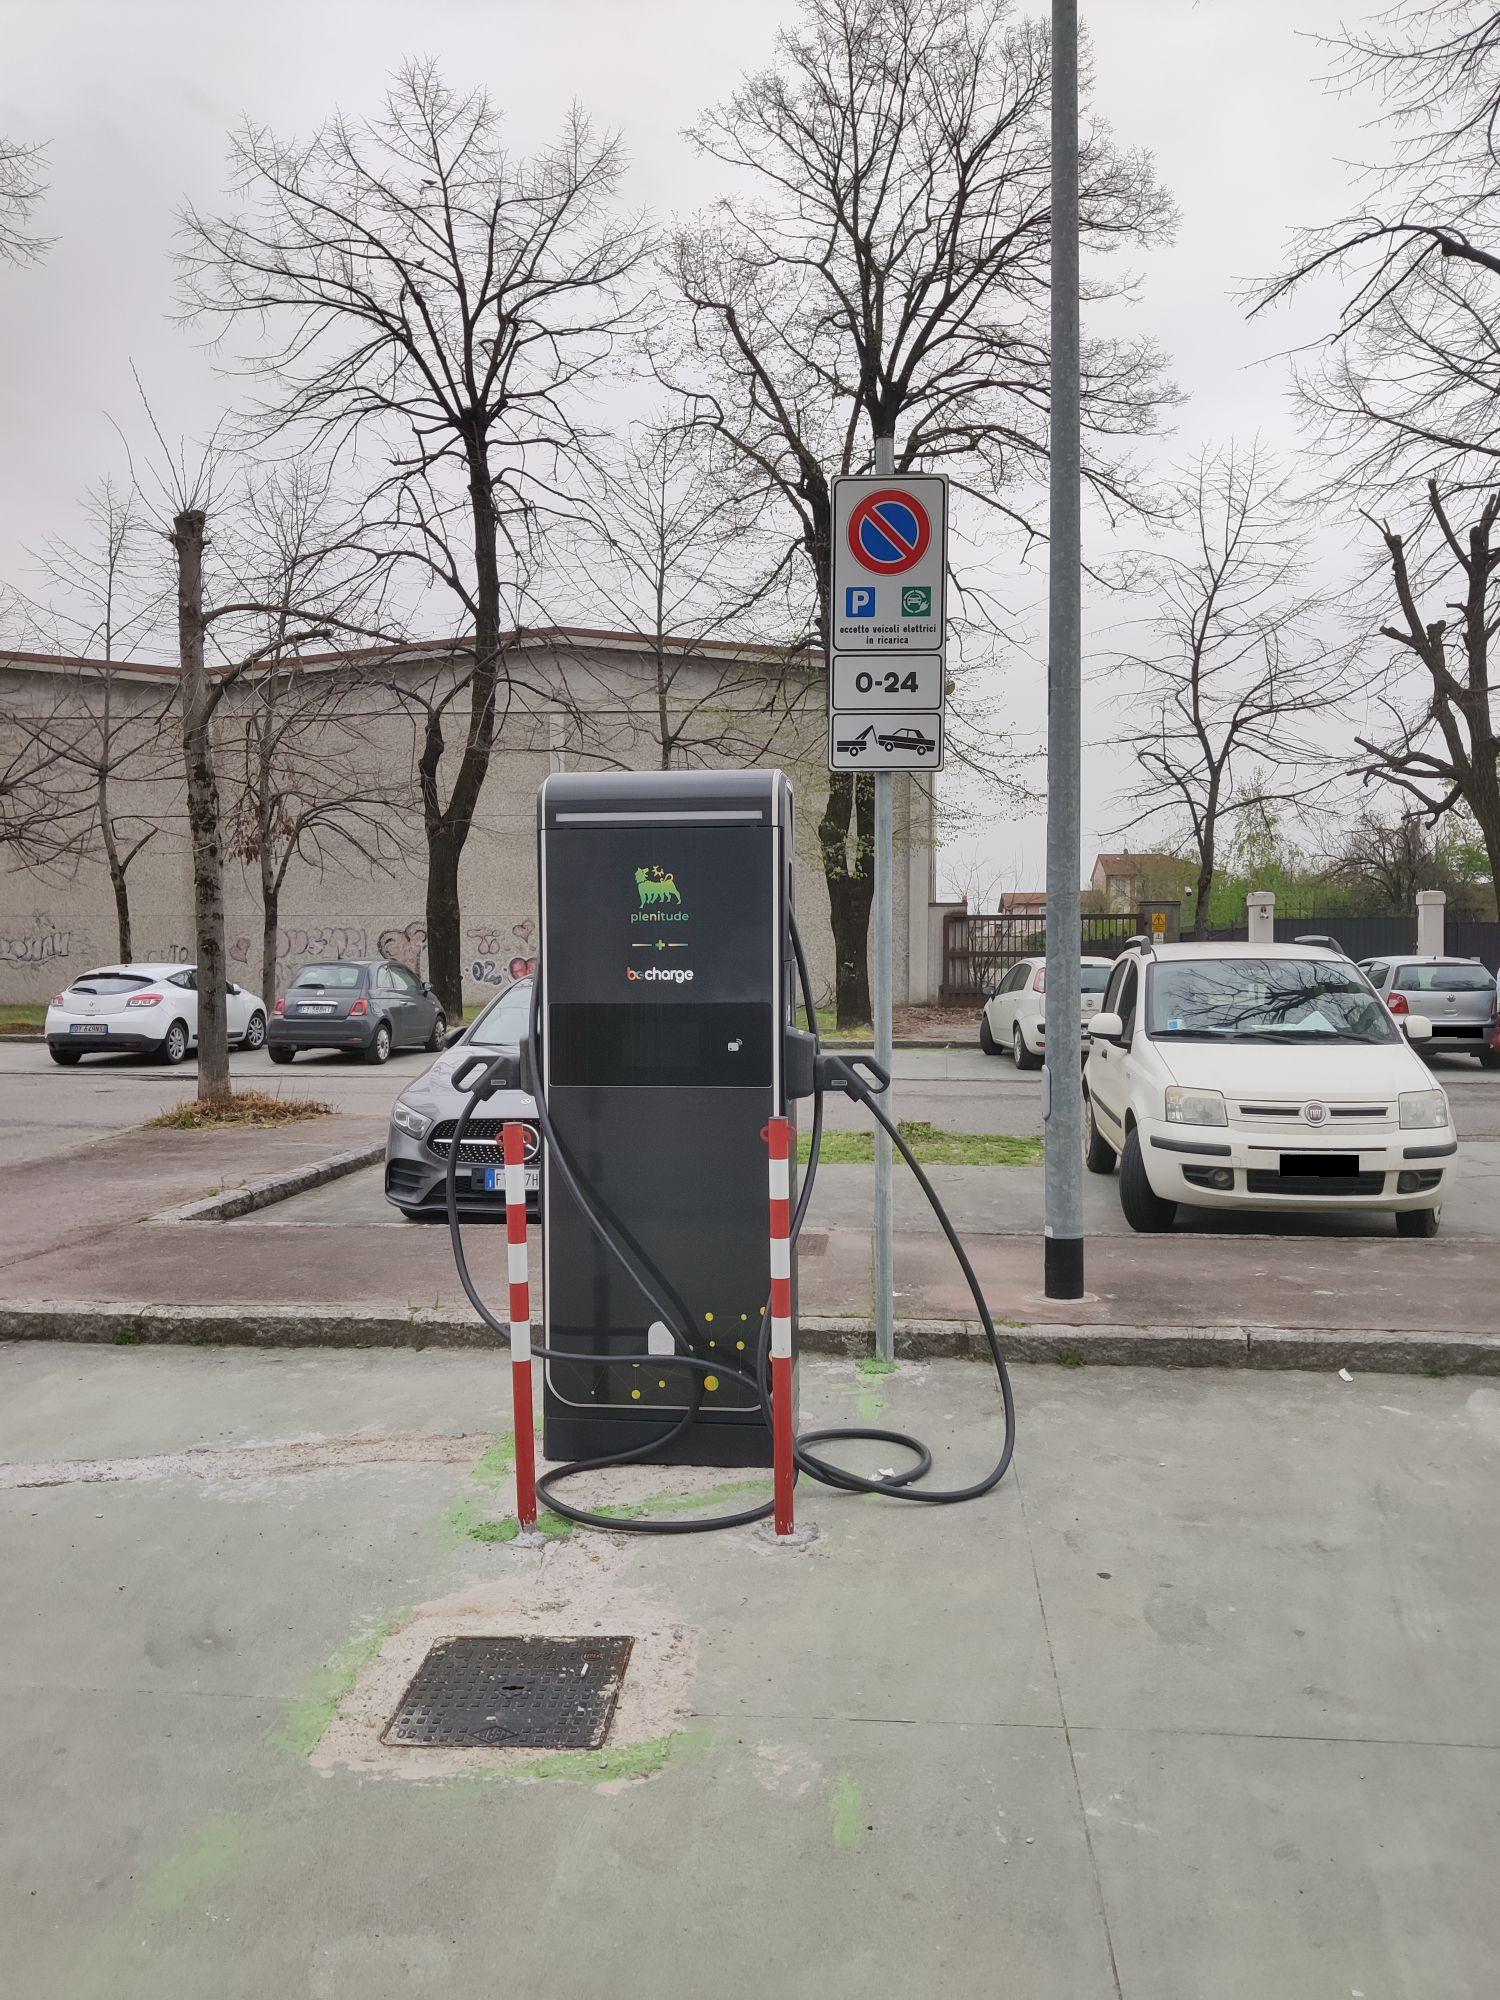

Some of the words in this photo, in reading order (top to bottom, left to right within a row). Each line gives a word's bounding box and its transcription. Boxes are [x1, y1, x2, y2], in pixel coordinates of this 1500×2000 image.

[852, 590, 870, 614] P
[839, 624, 870, 634] eccetto
[872, 624, 900, 634] veicoli
[902, 623, 937, 633] elettrici
[866, 635, 874, 644] in
[877, 635, 909, 644] ricarica
[855, 671, 919, 693] 0-24
[630, 910, 690, 924] plenitude
